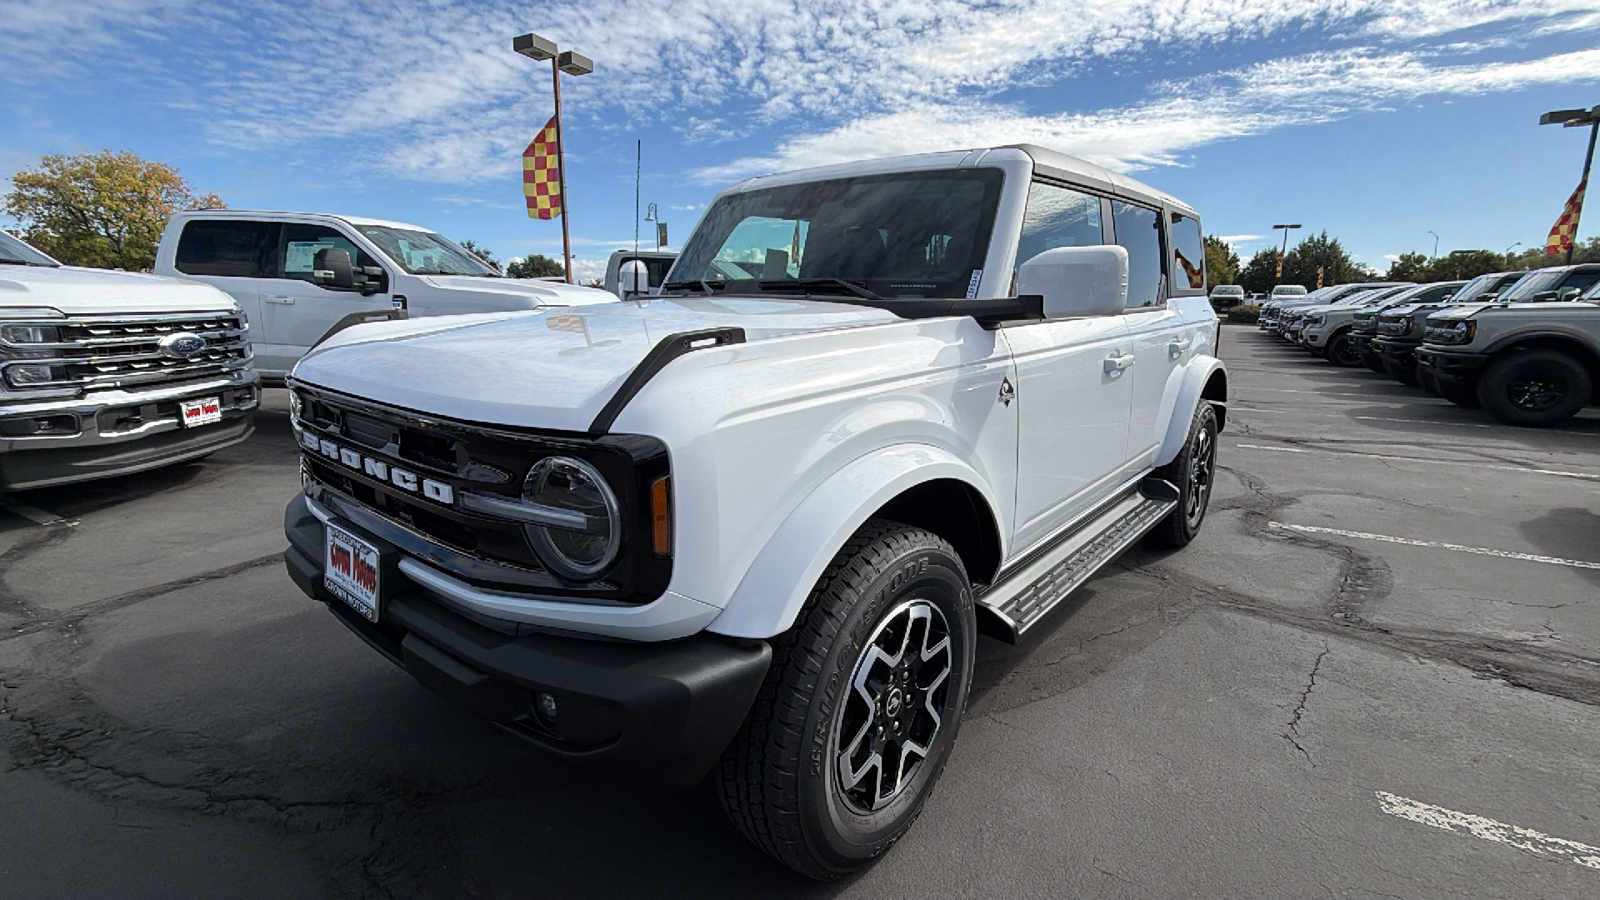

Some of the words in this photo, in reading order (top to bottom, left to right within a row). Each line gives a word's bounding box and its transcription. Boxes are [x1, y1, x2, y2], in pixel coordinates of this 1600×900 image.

[302, 431, 454, 505] BRONCO
[326, 579, 347, 601] CROWN
[347, 595, 373, 619] MOTORS
[809, 555, 930, 779] BRIDGESTONE
